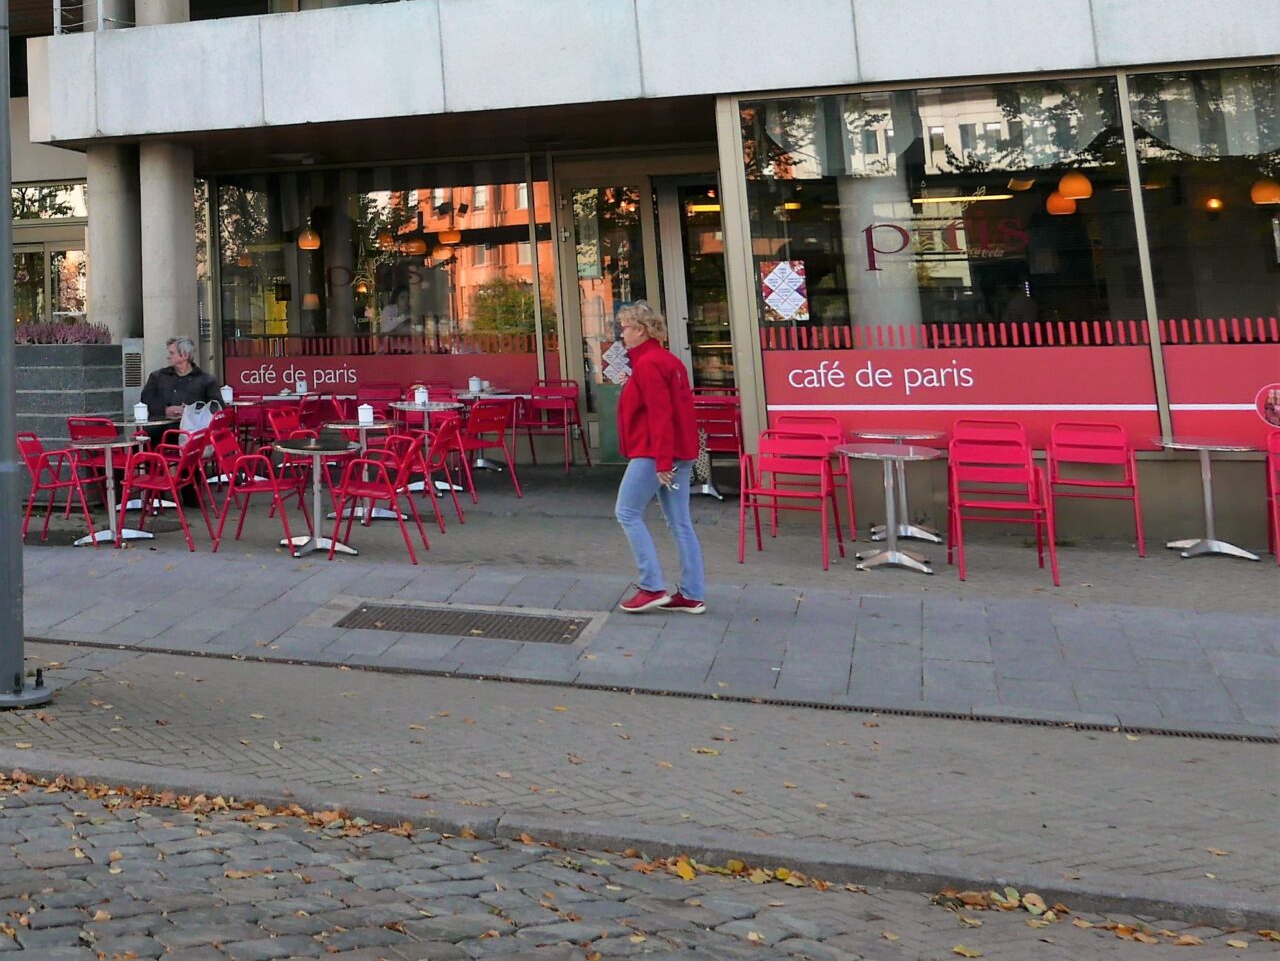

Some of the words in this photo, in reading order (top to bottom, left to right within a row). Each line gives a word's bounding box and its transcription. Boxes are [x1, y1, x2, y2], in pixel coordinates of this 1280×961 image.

[240, 363, 276, 384] café
[283, 364, 306, 384] de
[313, 363, 357, 389] paris
[787, 360, 845, 388] café
[855, 360, 893, 388] de
[903, 359, 975, 396] paris
